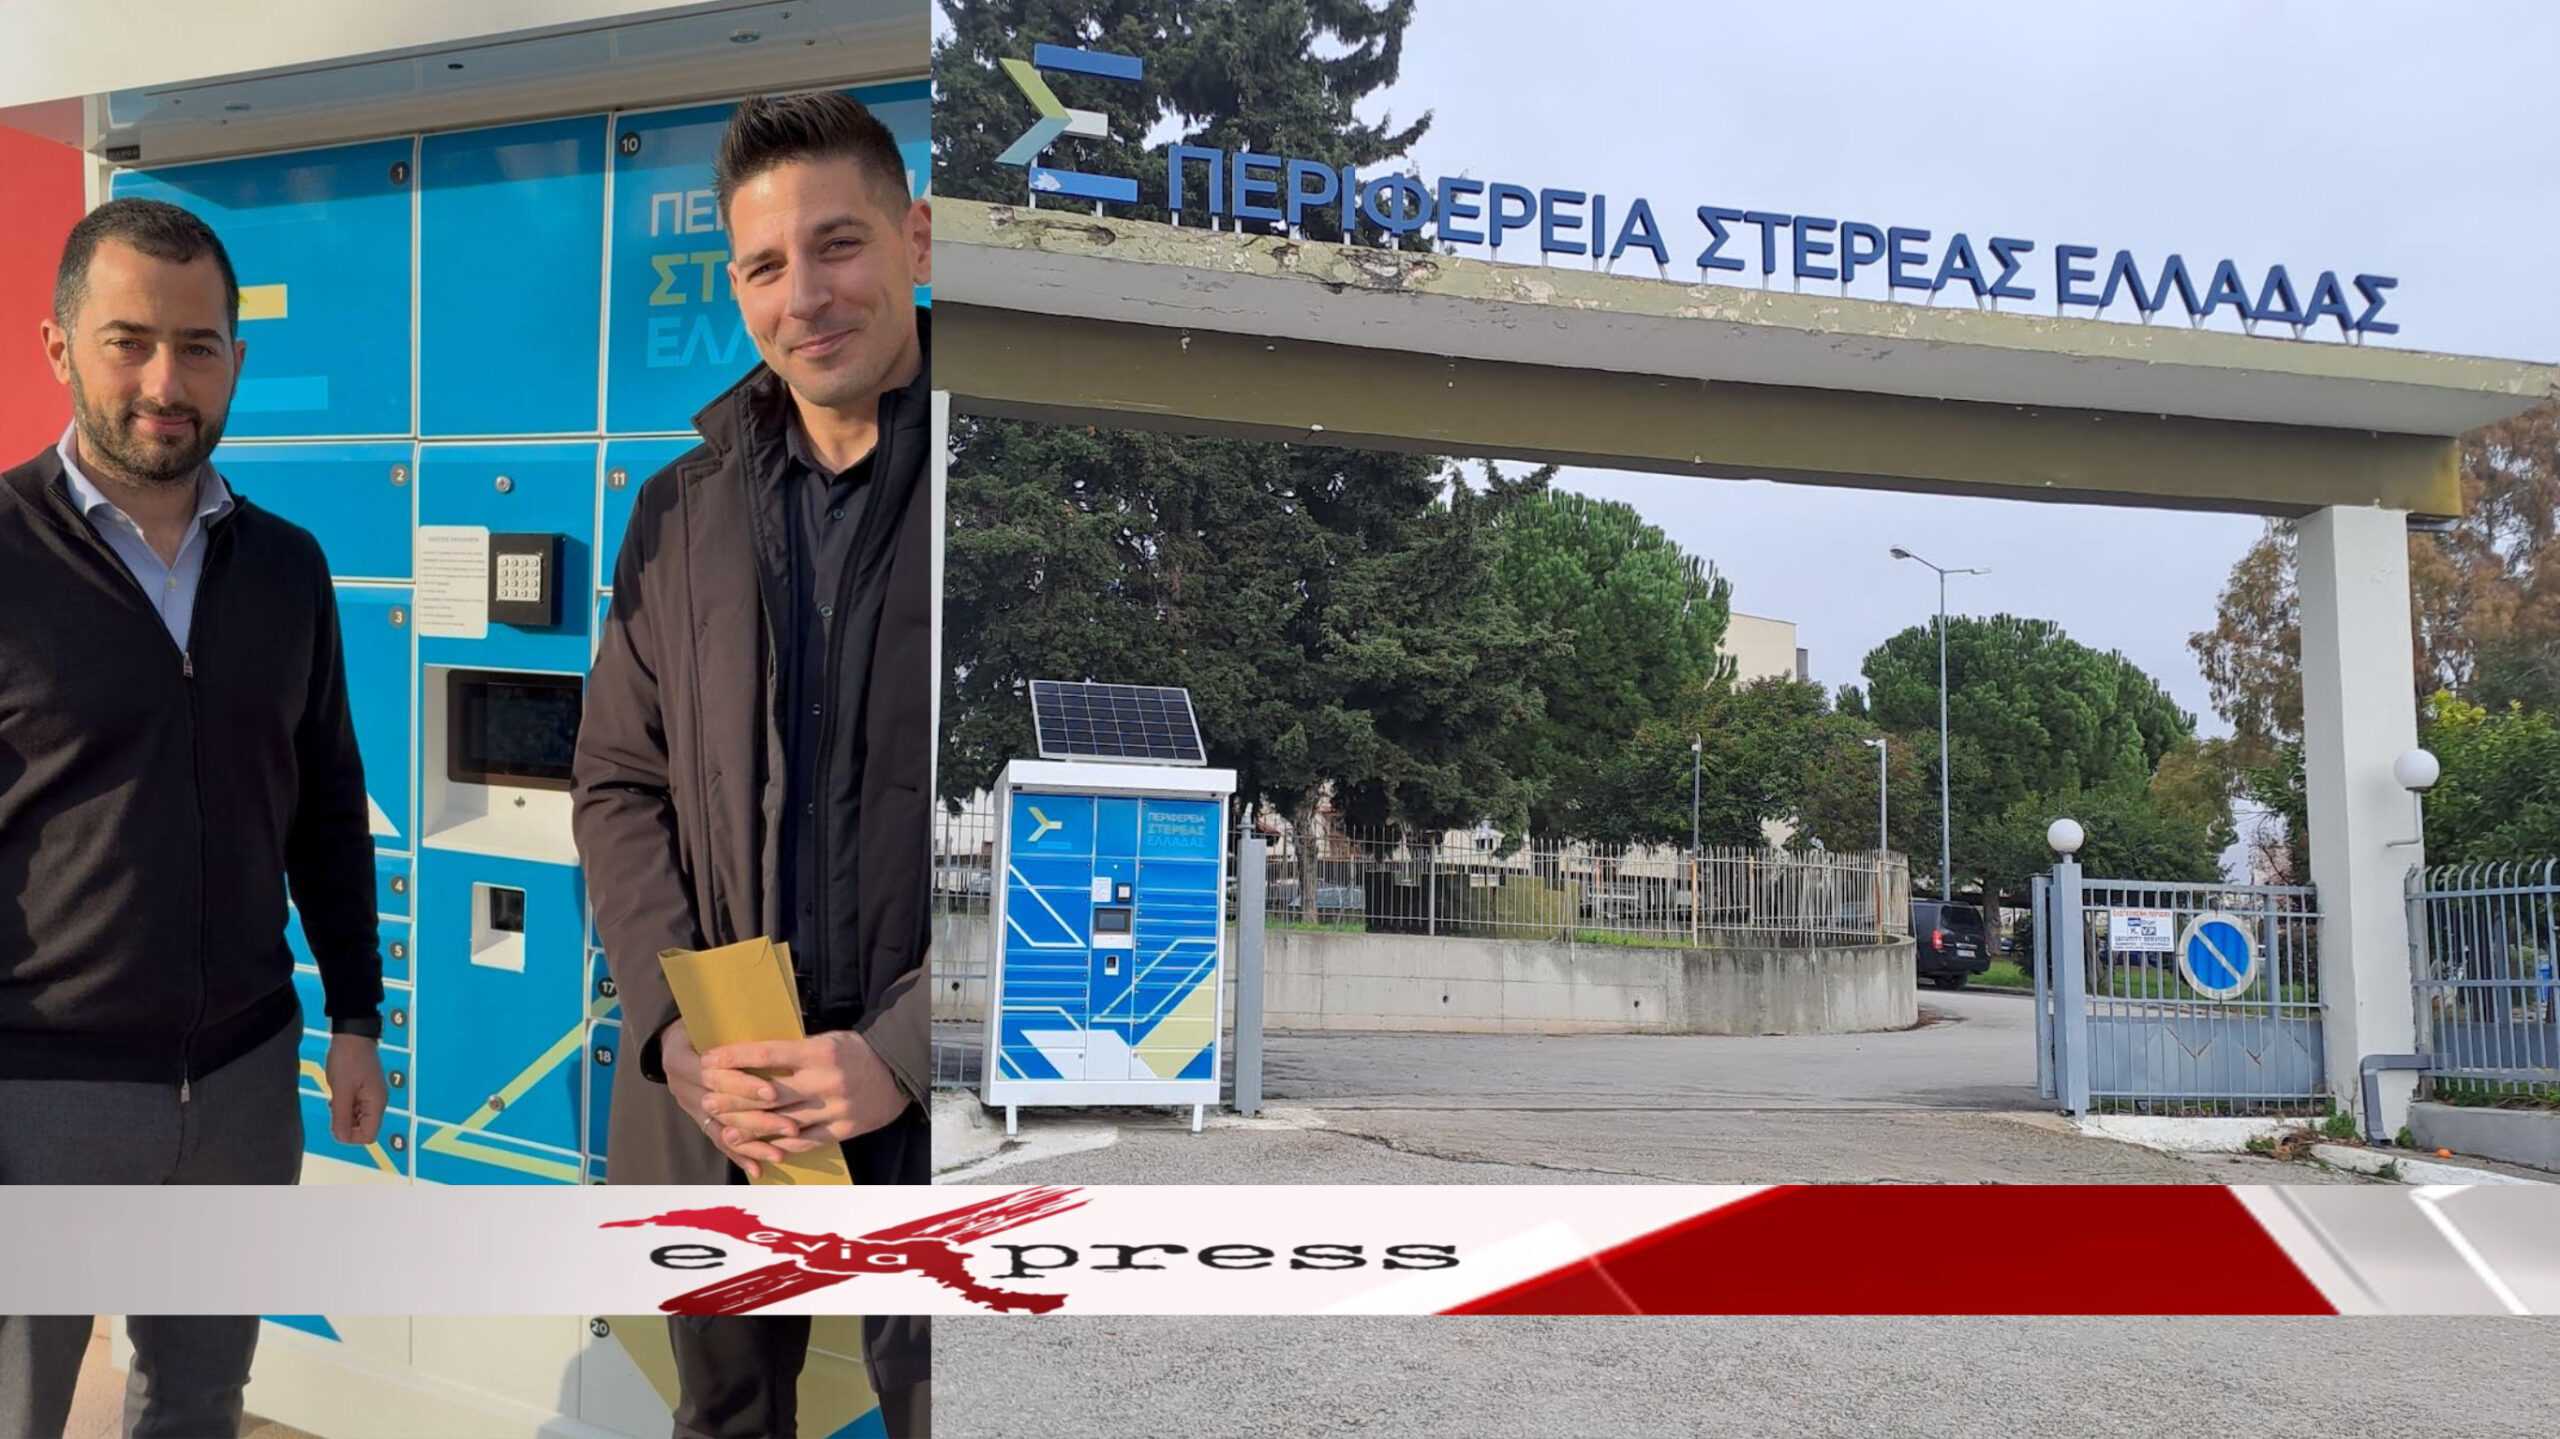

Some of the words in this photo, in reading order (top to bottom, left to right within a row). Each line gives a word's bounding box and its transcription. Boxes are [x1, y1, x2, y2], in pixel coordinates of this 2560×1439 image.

[621, 138, 638, 152] 10
[1168, 145, 1669, 264] ΠΕΡΙΦΕΡΕΙΑ
[1697, 205, 2035, 299] ΣΤΕΡΕΑΣ
[2055, 245, 2399, 334] ΕΛΛΑΔΑΣ
[592, 1320, 608, 1334] 20
